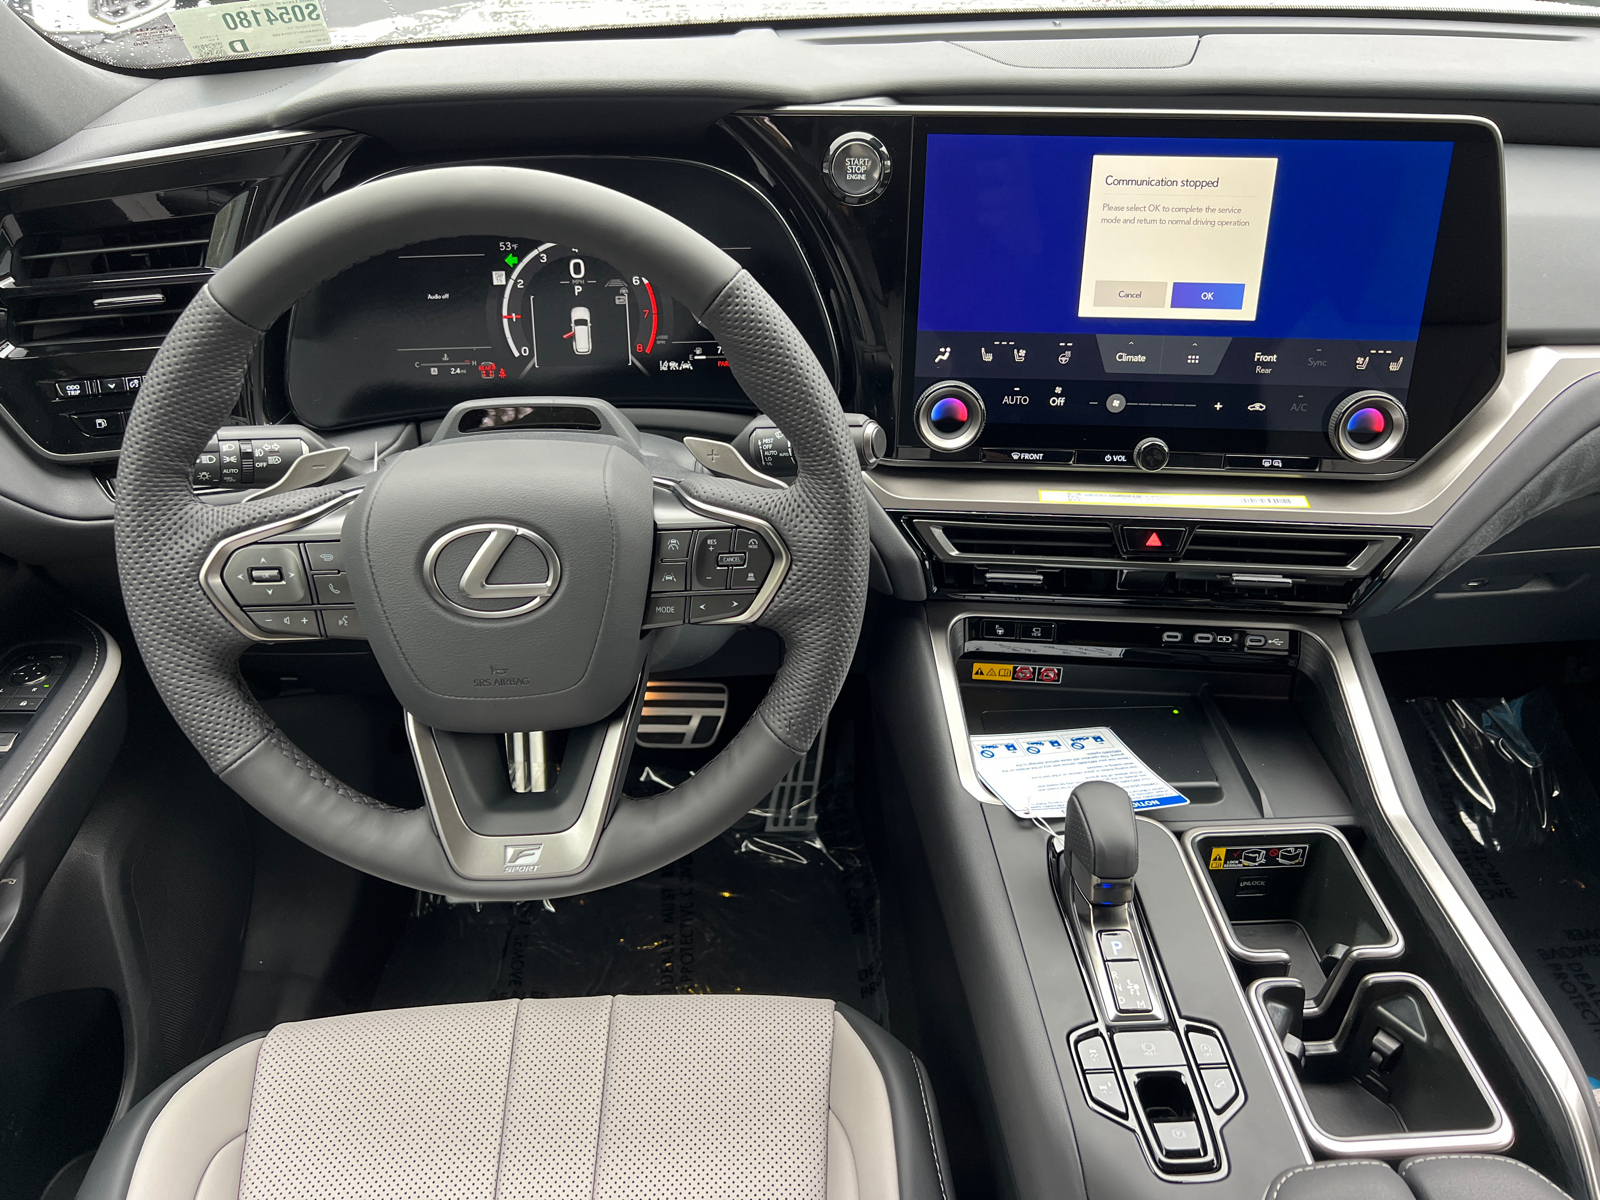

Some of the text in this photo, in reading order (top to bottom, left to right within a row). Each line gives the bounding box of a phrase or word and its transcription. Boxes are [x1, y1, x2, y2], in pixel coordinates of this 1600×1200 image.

[846, 158, 869, 166] START
[1105, 174, 1220, 190] Communication stopped
[1102, 203, 1125, 212] Please
[1126, 204, 1147, 212] select
[1148, 204, 1161, 212] OK
[1171, 205, 1202, 214] complete
[1101, 216, 1121, 224] mode
[1193, 218, 1216, 227] driving
[1217, 219, 1250, 227] operation
[540, 254, 547, 263] 3
[569, 258, 585, 278] 0
[517, 280, 524, 288] 2
[632, 276, 640, 285] 6
[574, 286, 582, 296] P
[1118, 291, 1142, 299] Cancel
[1201, 292, 1214, 300] OK
[643, 310, 650, 318] 7
[522, 346, 529, 356] 0
[636, 343, 643, 353] 8
[1116, 352, 1146, 362] Climate
[1254, 352, 1277, 362] Front
[1307, 357, 1327, 368] Sync
[1255, 365, 1272, 374] Rear
[1002, 395, 1030, 405] AUTO
[1049, 396, 1066, 406] Off
[1290, 403, 1308, 412] A/C
[473, 676, 530, 687] SRS AIRBAG
[1132, 799, 1160, 808] NOTIC
[1110, 940, 1123, 956] P
[1112, 971, 1119, 979] R
[1114, 983, 1122, 991] N
[1118, 996, 1125, 1004] D
[1136, 1000, 1146, 1008] M
